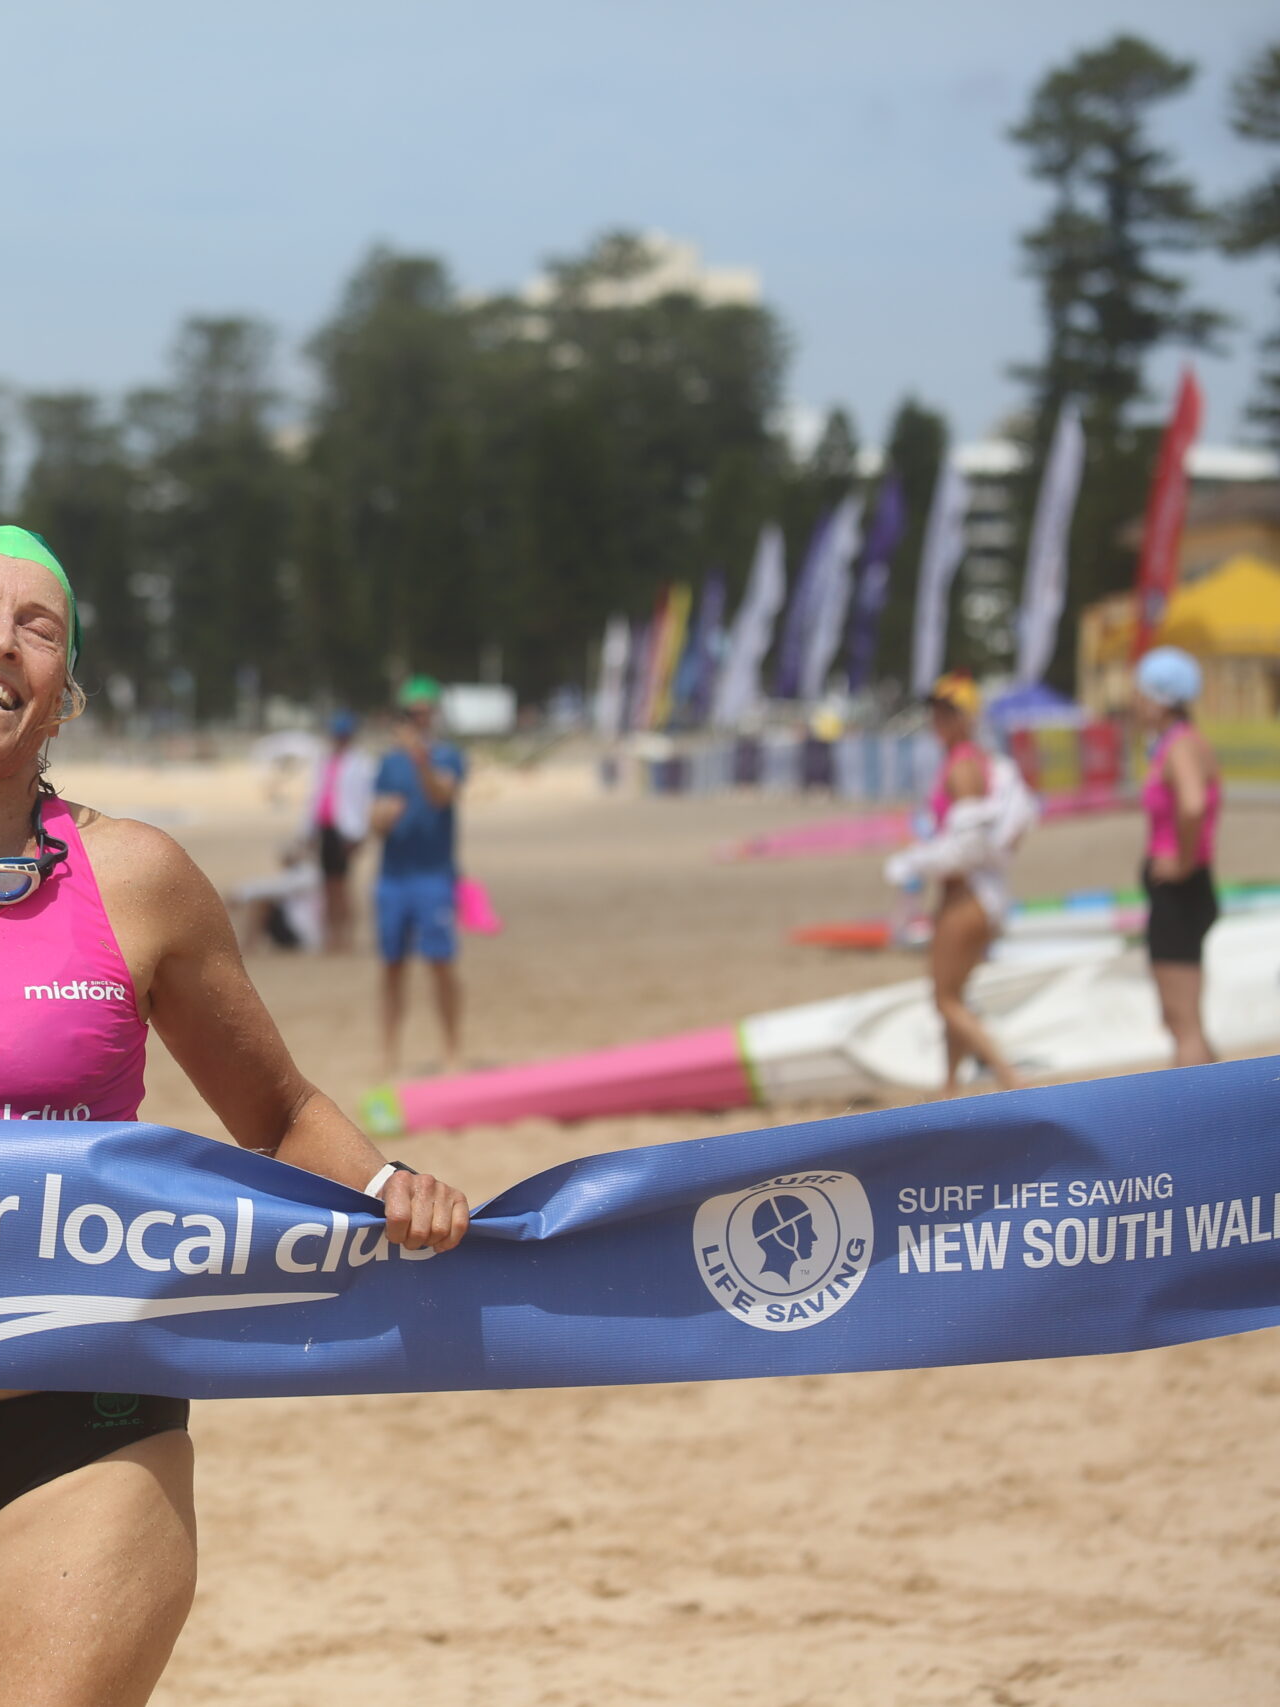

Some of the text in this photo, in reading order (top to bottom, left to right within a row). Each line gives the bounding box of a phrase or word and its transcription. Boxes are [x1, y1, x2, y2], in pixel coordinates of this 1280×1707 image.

[39, 1173, 254, 1275] local
[275, 1210, 438, 1274] clu
[897, 1172, 1173, 1214] SURF LIFE SAVING
[897, 1221, 1011, 1274] NEW
[1023, 1209, 1173, 1269] SOUTH
[701, 1237, 866, 1323] LIFE SAVING
